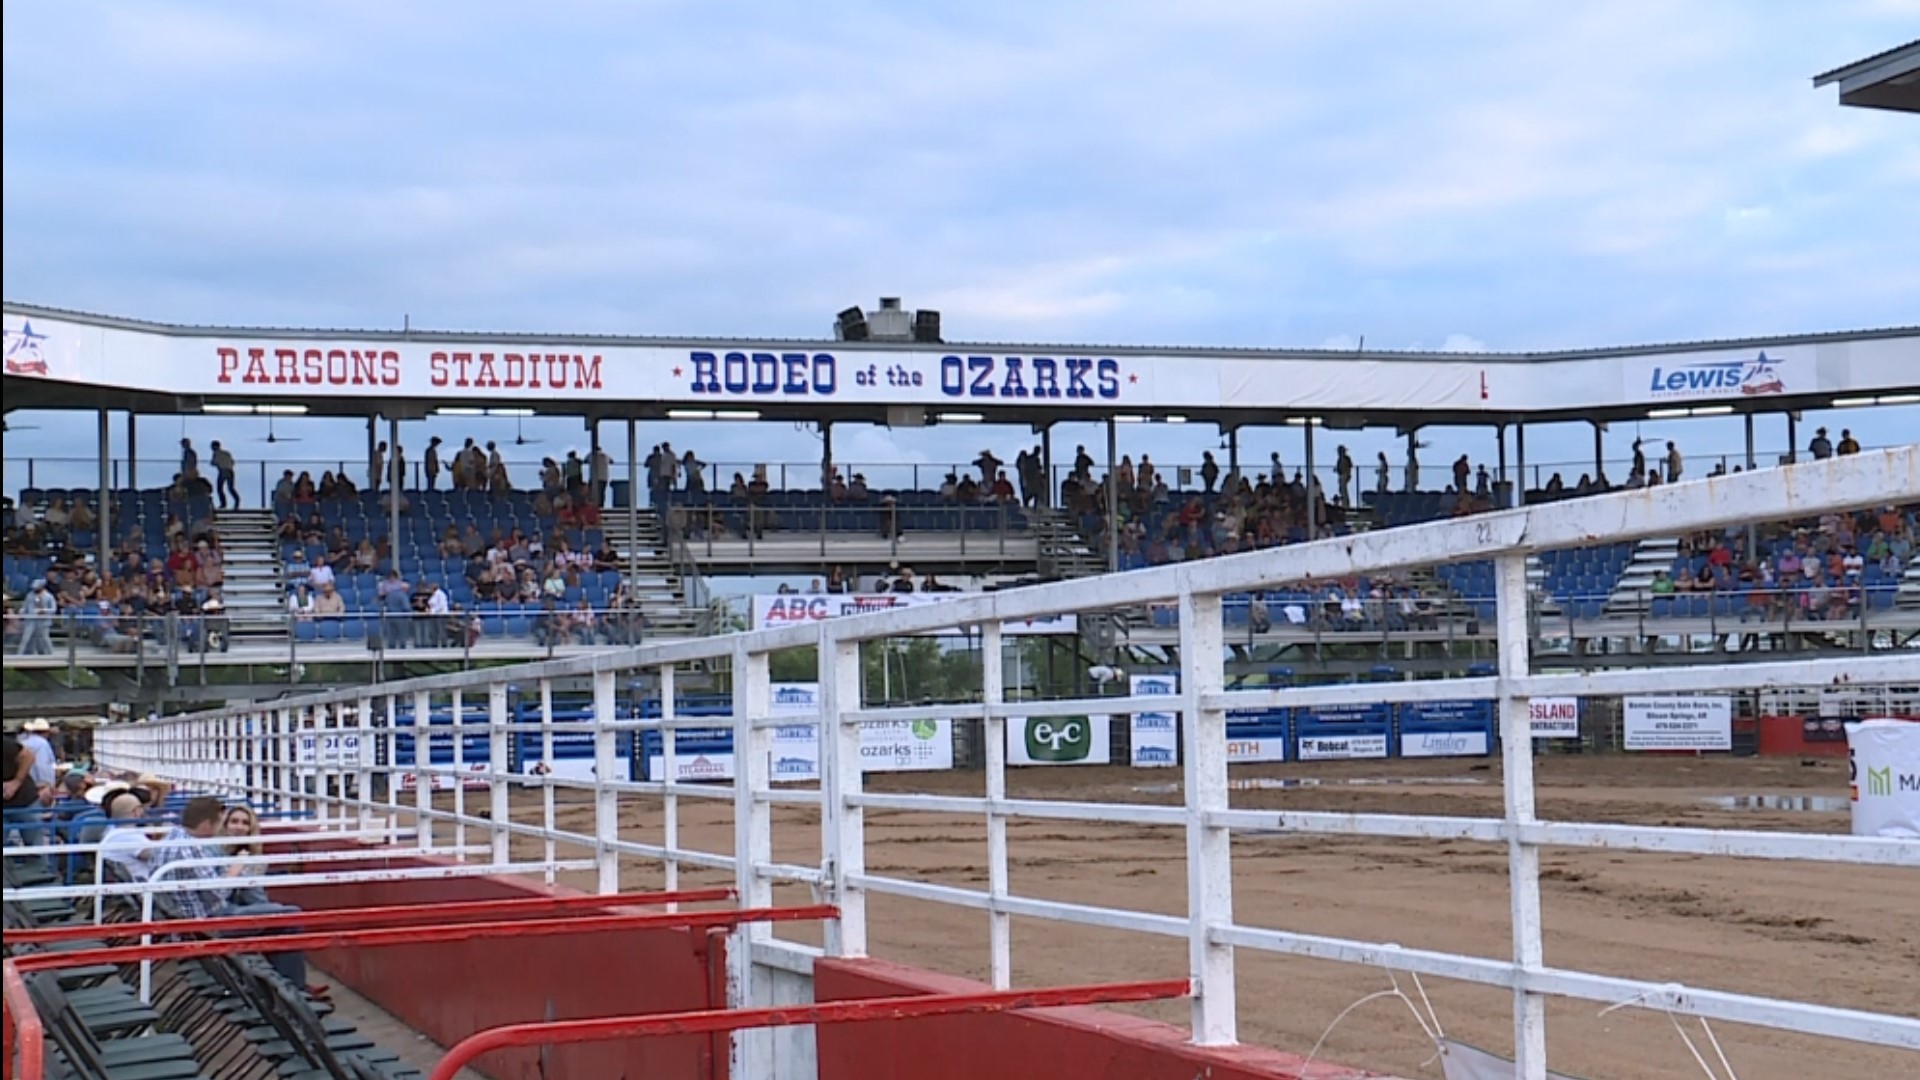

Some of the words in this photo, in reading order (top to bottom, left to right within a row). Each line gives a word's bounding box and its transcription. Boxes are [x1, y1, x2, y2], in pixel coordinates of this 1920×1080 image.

[216, 347, 400, 385] PARSONS
[430, 351, 603, 389] STADIUM
[690, 351, 837, 395] RODEO
[855, 366, 876, 386] of
[887, 364, 922, 387] the
[940, 356, 1121, 399] OZARKS
[1651, 366, 1741, 391] Lewis
[1475, 522, 1492, 545] 22
[765, 598, 828, 621] ABC
[1653, 702, 1675, 710] County
[1530, 722, 1576, 731] ONTRACTORS
[861, 742, 911, 757] ozarks
[1227, 742, 1259, 755] ATH
[1317, 740, 1349, 753] Bobcat
